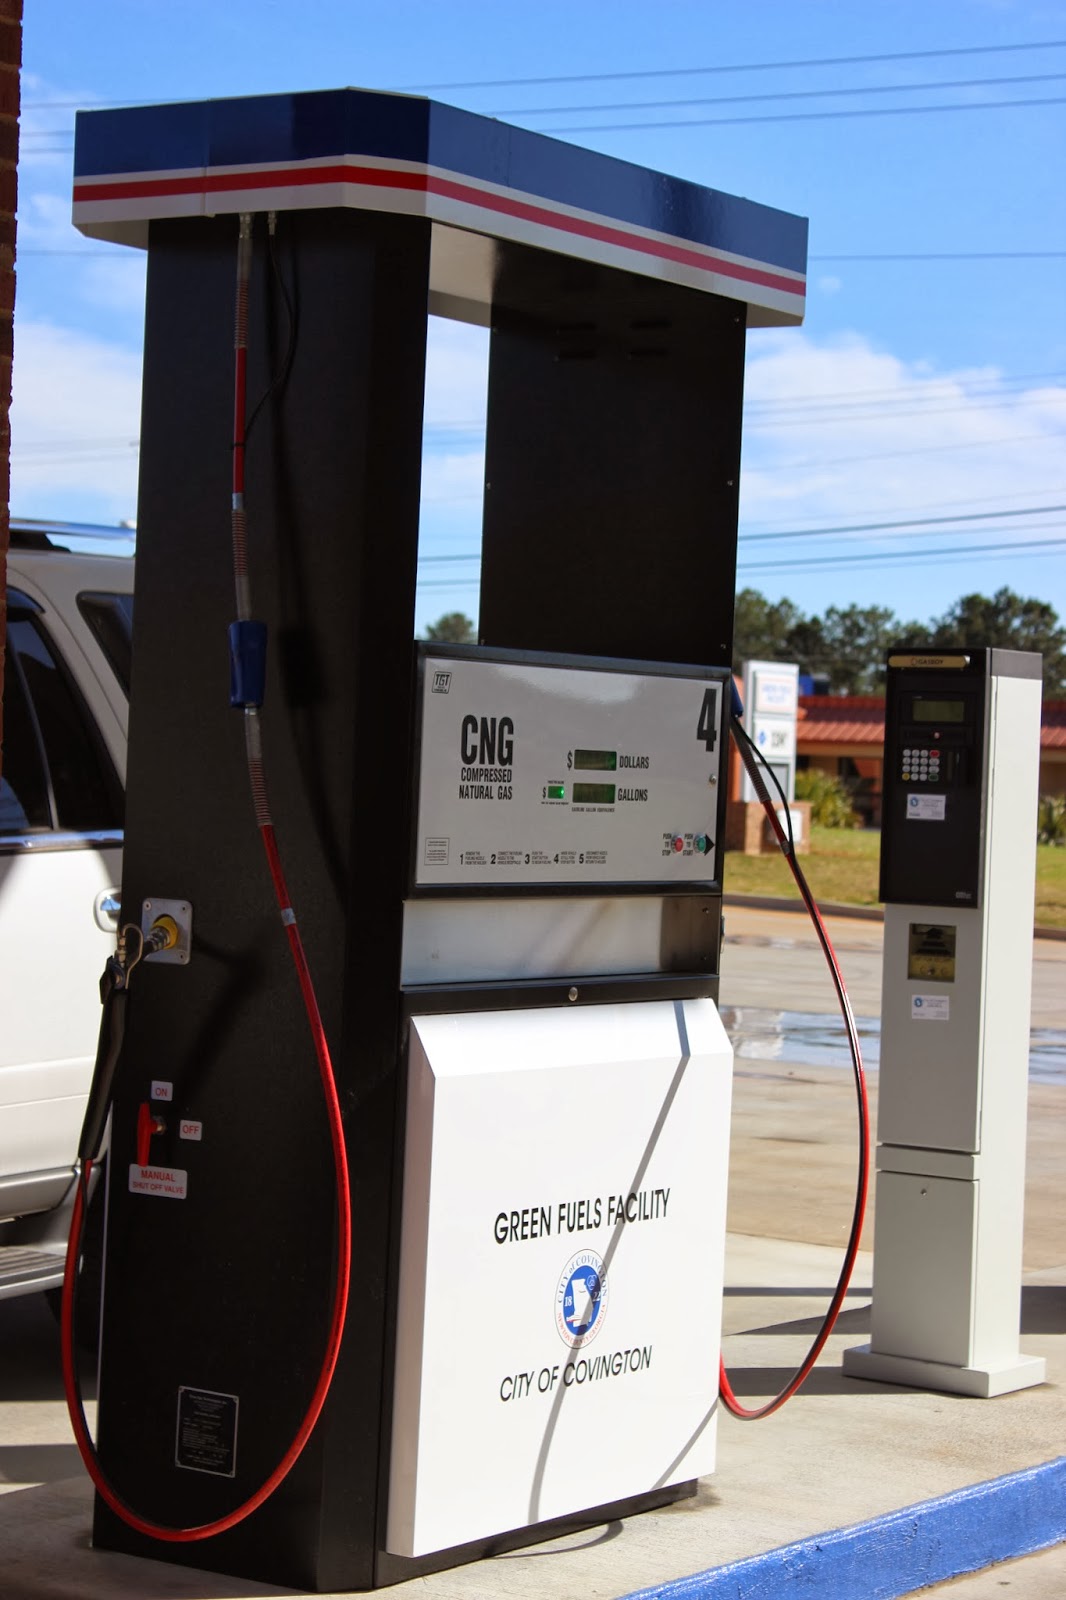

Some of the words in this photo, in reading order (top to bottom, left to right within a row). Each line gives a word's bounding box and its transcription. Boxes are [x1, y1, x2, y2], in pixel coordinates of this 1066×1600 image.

[696, 688, 717, 752] 4
[461, 714, 514, 766] CNG
[567, 750, 573, 771] $
[619, 755, 650, 769] DOLLARS
[461, 767, 512, 783] COMPRESSED
[459, 785, 494, 800] NATURAL
[497, 785, 513, 800] GAS
[542, 786, 547, 799] $
[617, 788, 648, 801] GALLONS
[460, 854, 464, 865] 1
[490, 854, 496, 864] 2
[525, 854, 530, 864] 3
[554, 854, 559, 864] 4
[579, 854, 584, 864] 5
[155, 1087, 168, 1097] ON
[182, 1125, 199, 1134] OFF
[141, 1170, 176, 1182] MANUAL
[133, 1181, 149, 1190] SHUT
[150, 1183, 162, 1191] OFF
[164, 1185, 184, 1194] VALVE
[494, 1205, 552, 1244] GREEN
[557, 1198, 602, 1234] FUELS
[607, 1188, 671, 1226] FACILITY
[557, 1275, 569, 1303] CITY
[575, 1254, 607, 1296] COVINGTON
[565, 1296, 572, 1307] 18
[500, 1371, 535, 1402] CITY
[537, 1365, 559, 1393] OF
[563, 1345, 653, 1387] COVINGTON
